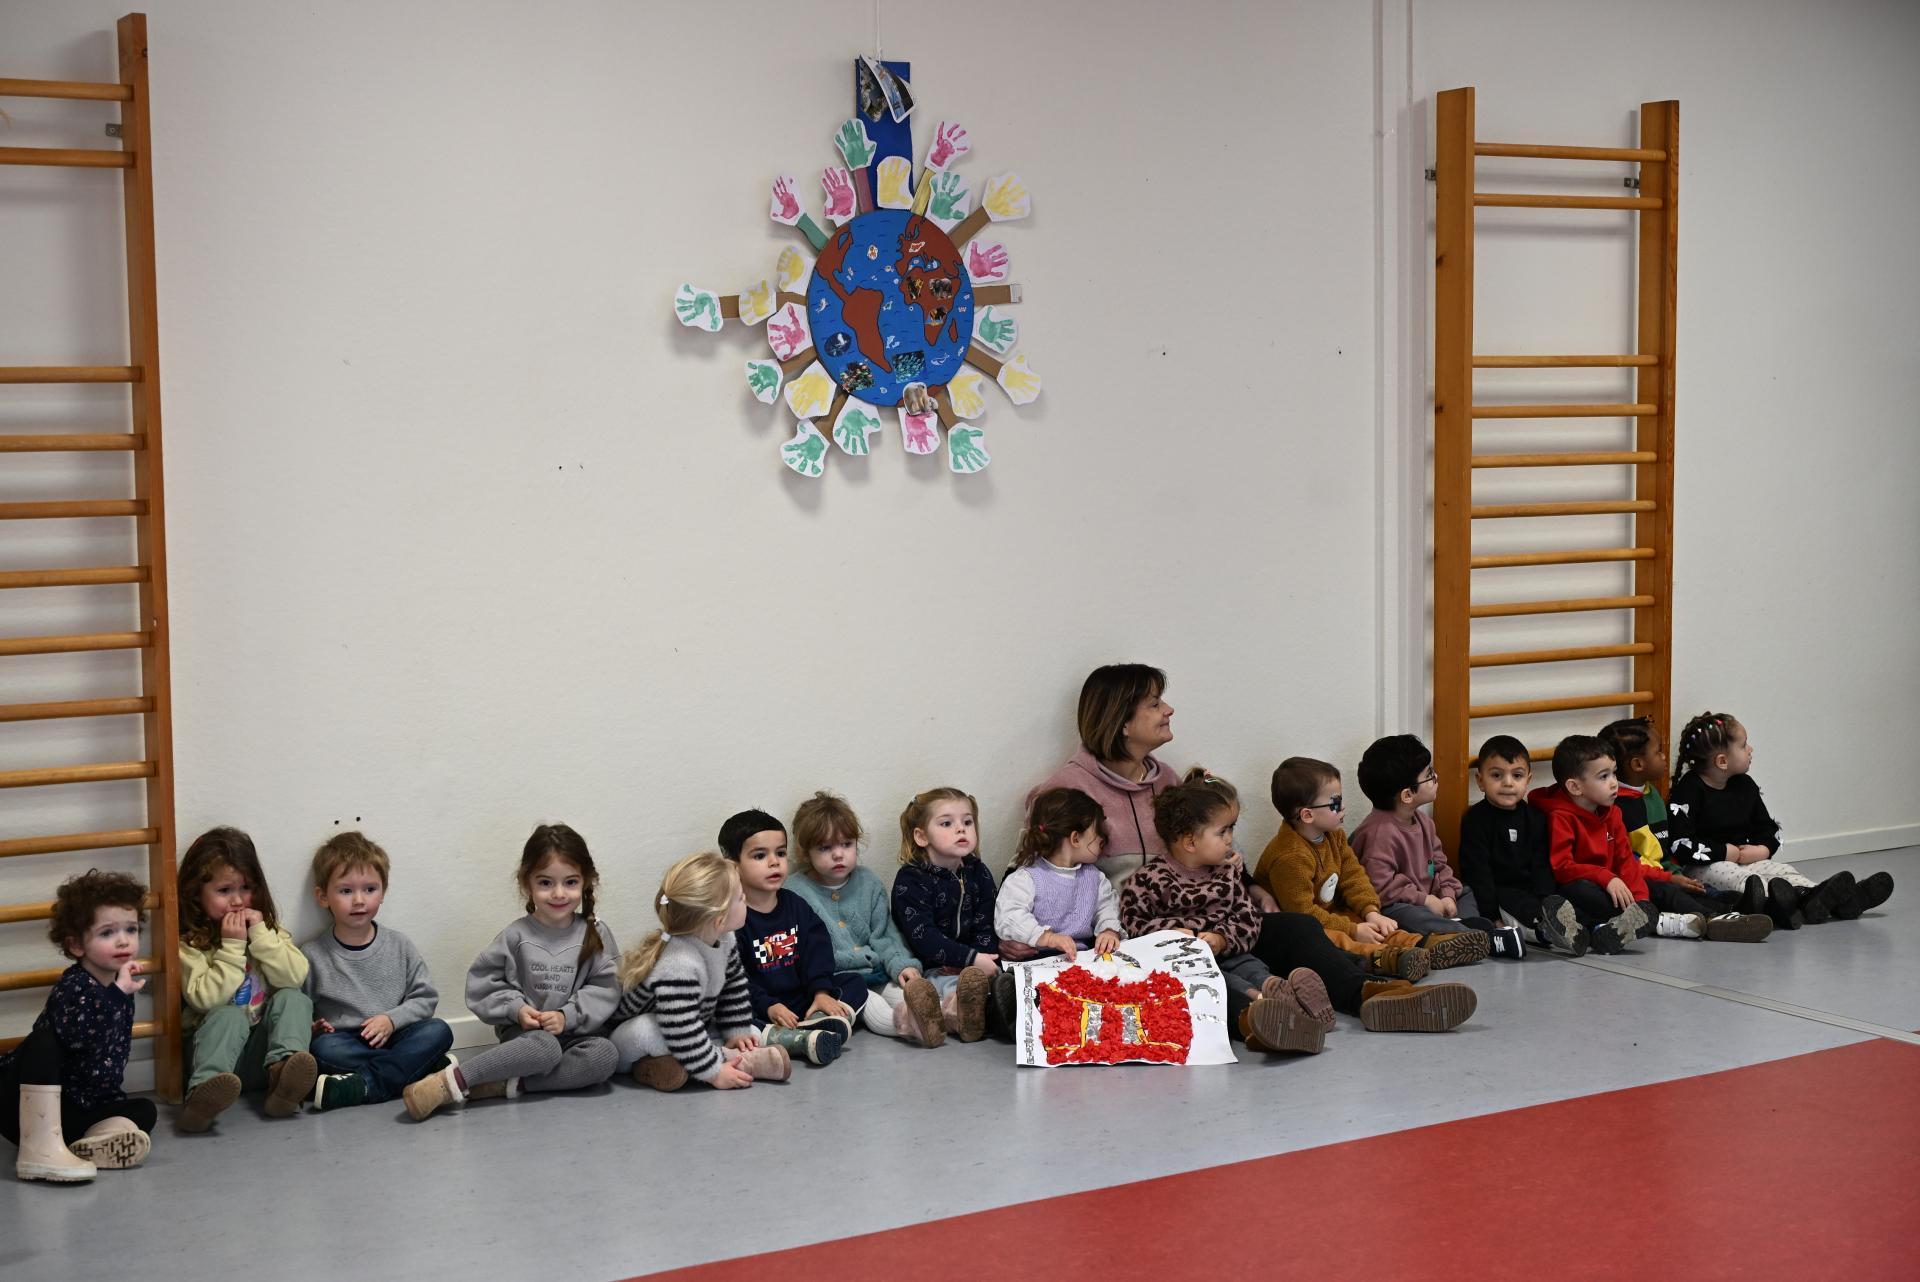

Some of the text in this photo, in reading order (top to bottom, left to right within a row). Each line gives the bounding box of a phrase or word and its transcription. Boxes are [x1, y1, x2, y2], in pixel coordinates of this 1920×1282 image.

[530, 963, 575, 973] COOL HEARTS
[544, 974, 560, 982] AND
